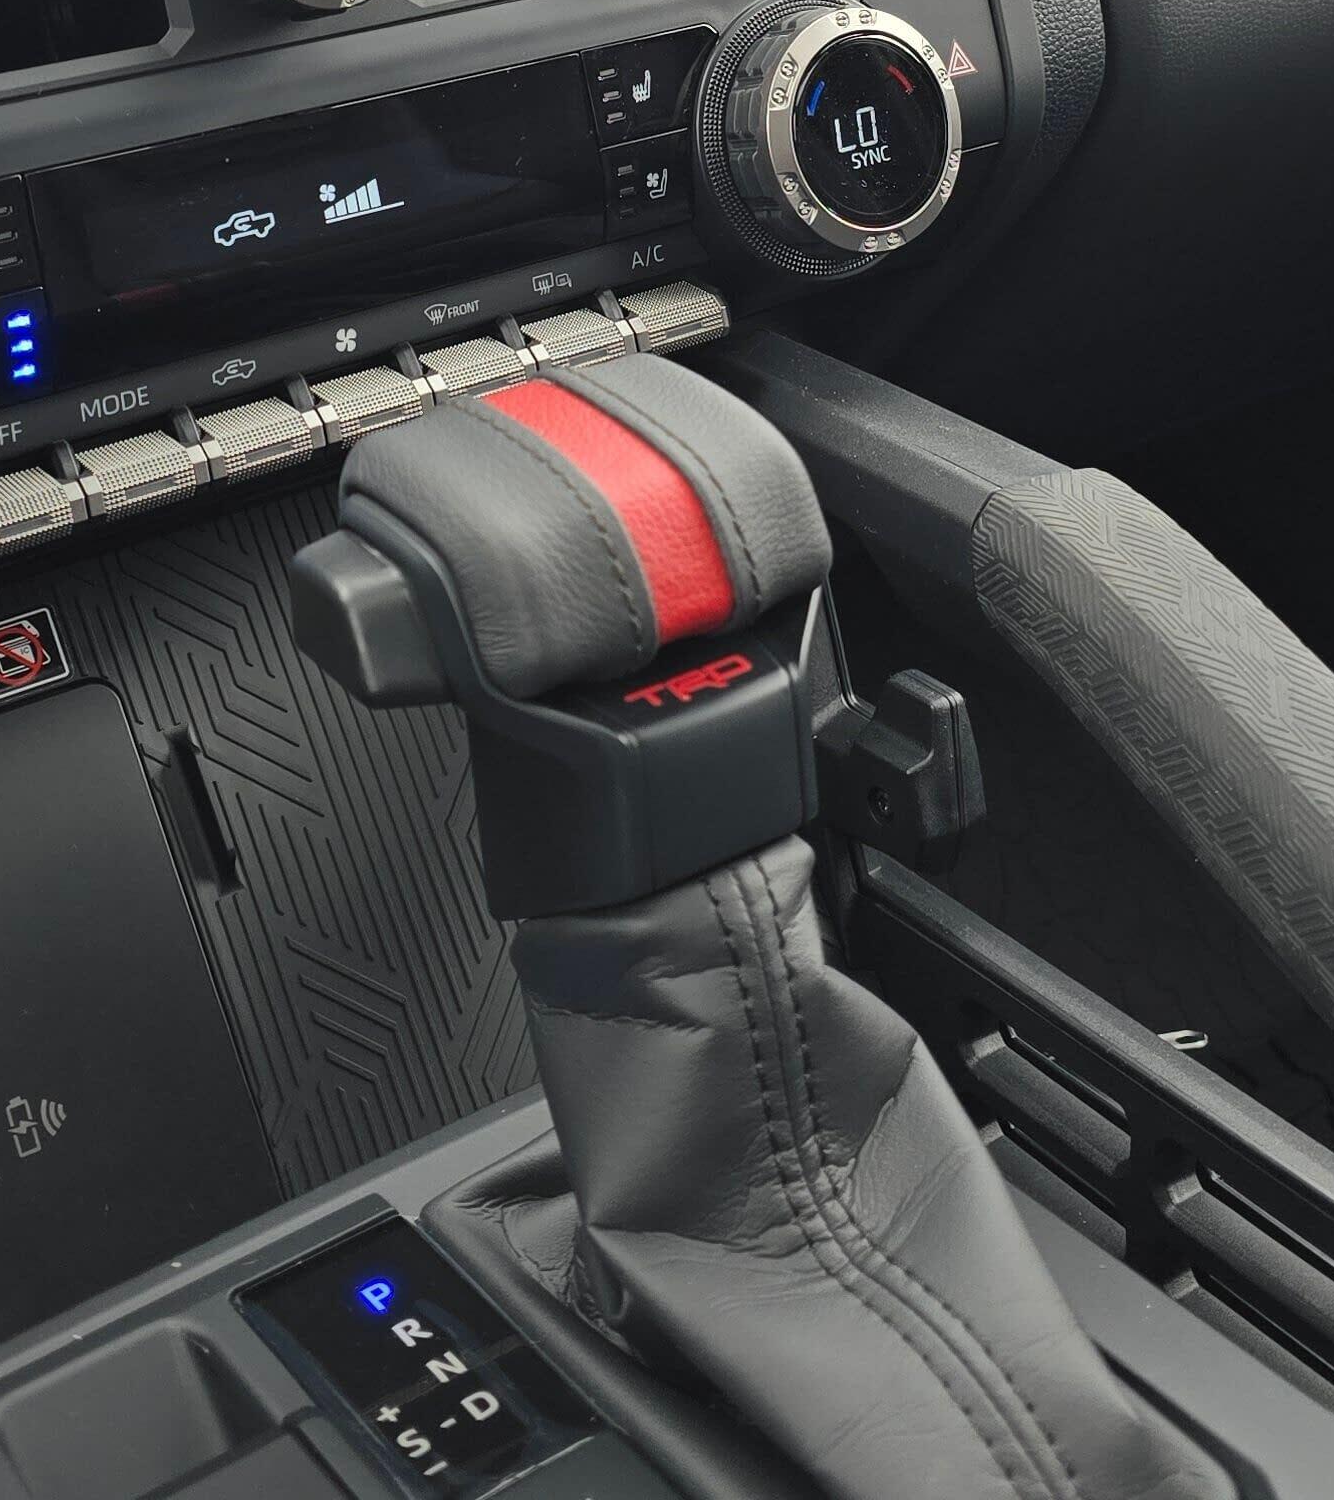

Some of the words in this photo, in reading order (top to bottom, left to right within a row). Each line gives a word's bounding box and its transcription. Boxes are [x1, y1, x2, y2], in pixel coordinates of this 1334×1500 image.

[834, 106, 879, 154] LO
[850, 145, 892, 170] SYNC
[630, 244, 666, 270] A/C
[446, 299, 481, 319] FRONT
[80, 385, 151, 422] MODE
[623, 653, 753, 707] TRD
[359, 1282, 392, 1312] P
[391, 1318, 434, 1348] R
[425, 1351, 468, 1383] N
[460, 1390, 500, 1421] D
[396, 1428, 431, 1458] S
